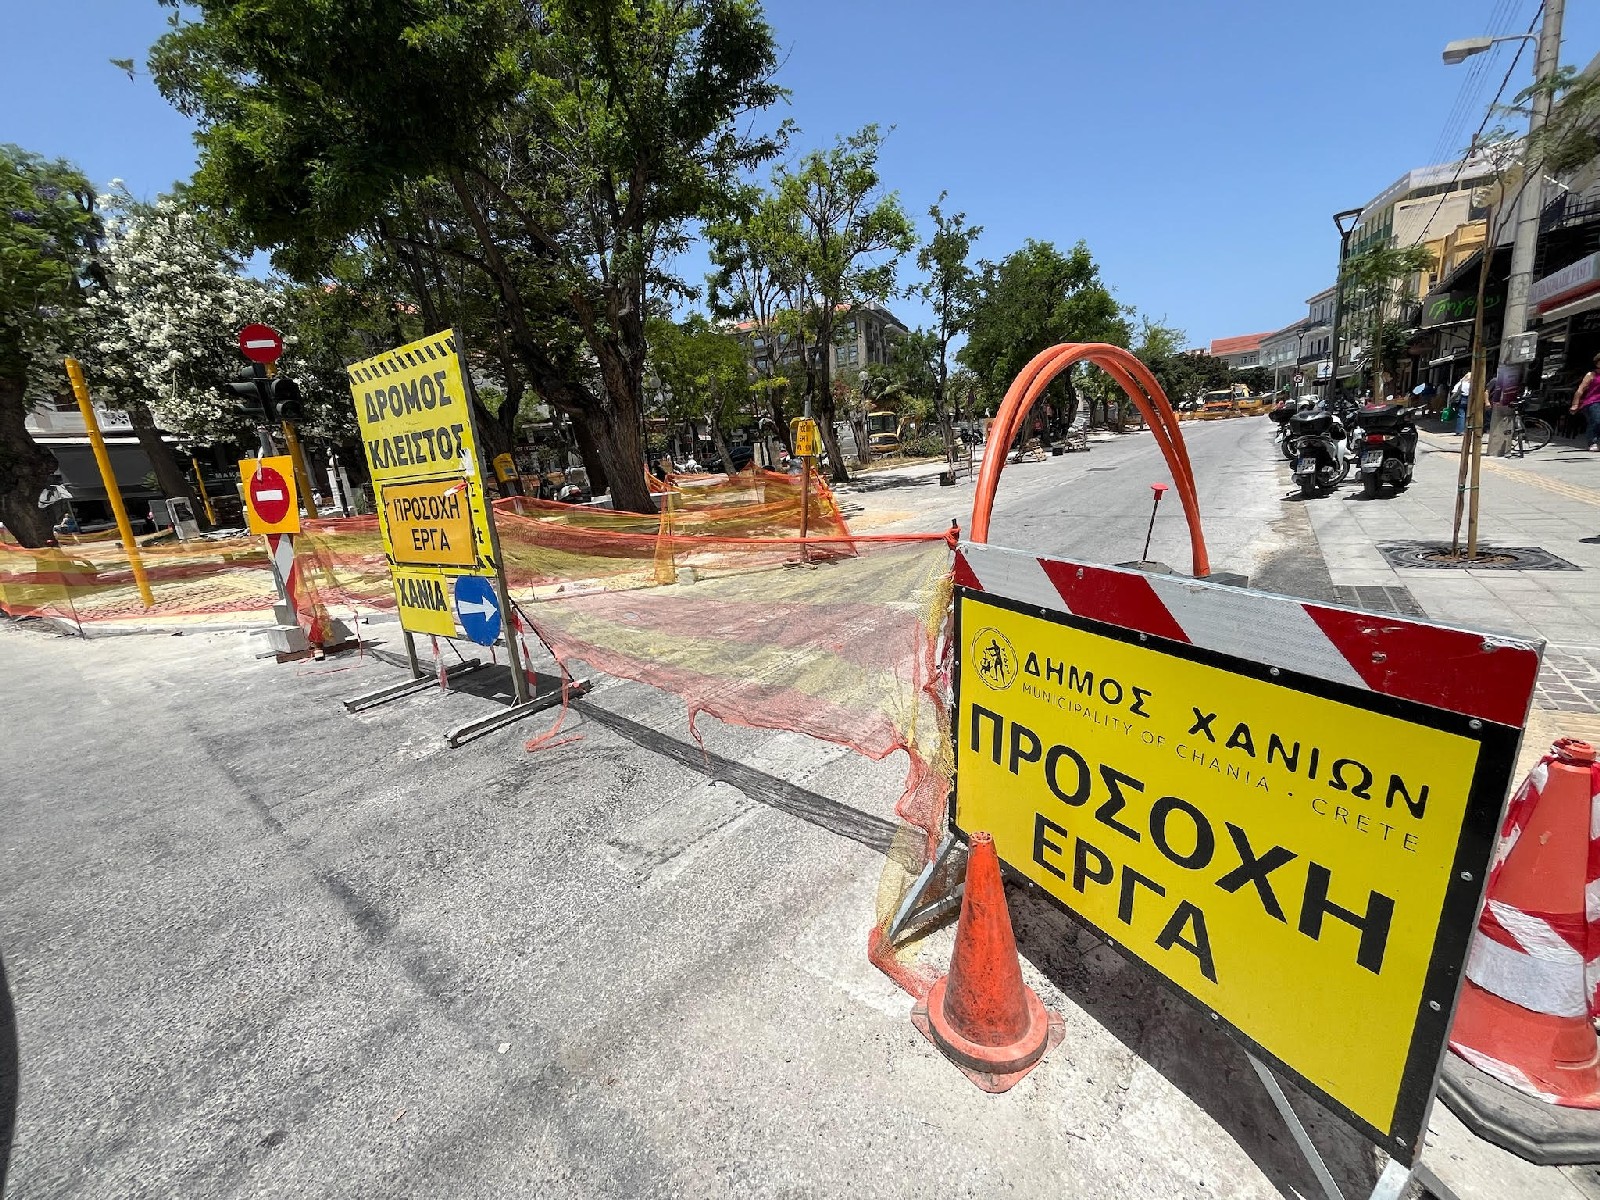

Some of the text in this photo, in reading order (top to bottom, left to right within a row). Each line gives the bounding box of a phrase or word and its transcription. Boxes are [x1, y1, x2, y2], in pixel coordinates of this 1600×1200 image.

[365, 371, 452, 423] ΔΡΟΜΟΣ
[368, 425, 466, 469] ΚΛΕΙΣΤΟΣ
[393, 495, 460, 522] ΠΡΟΣΟΧΗ
[412, 527, 451, 551] ΕΡΓΑ
[397, 577, 448, 612] ΧΑΝΙΑ
[1024, 651, 1430, 820] ΔΗΜΟΣ ΧΑΝΙΩΝ
[1022, 682, 1419, 853] MUNICIPALITY OF CHANIA CRETE
[970, 702, 1396, 976] ΠΡΟΣΟΧΗ
[1032, 813, 1218, 985] ΕΡΓΑ
